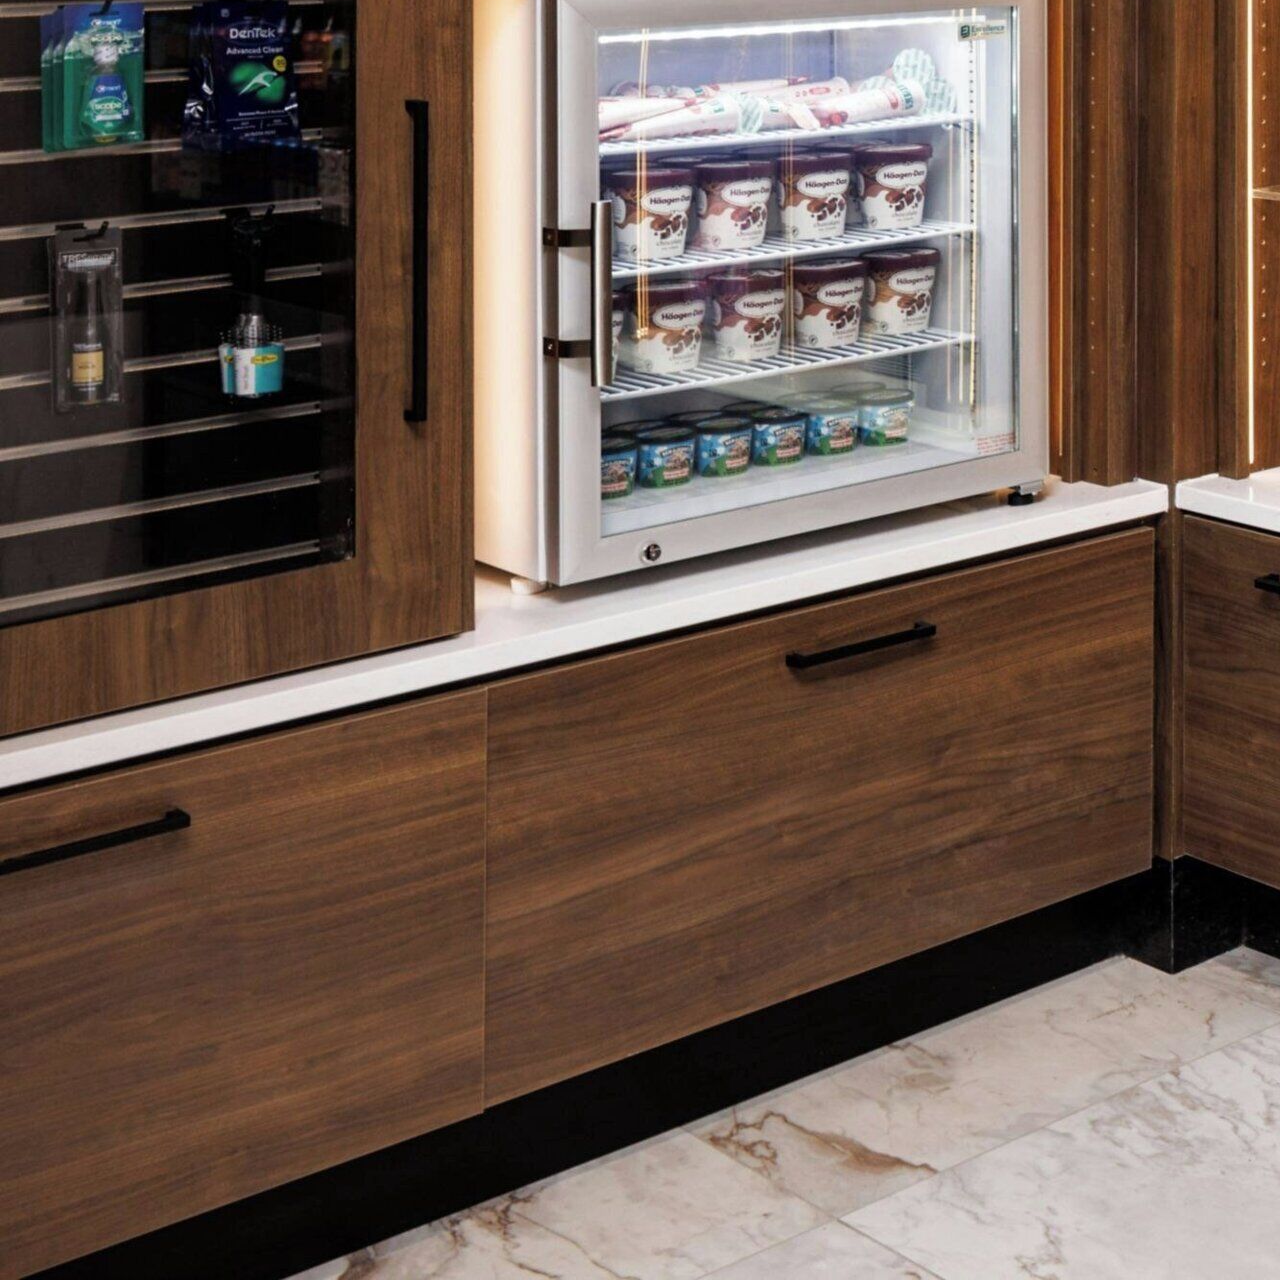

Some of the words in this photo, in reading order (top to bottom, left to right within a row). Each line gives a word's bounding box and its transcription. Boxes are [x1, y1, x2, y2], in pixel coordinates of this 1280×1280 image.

[229, 27, 276, 39] DenTek
[226, 46, 260, 55] Advanced
[263, 45, 283, 54] Clean
